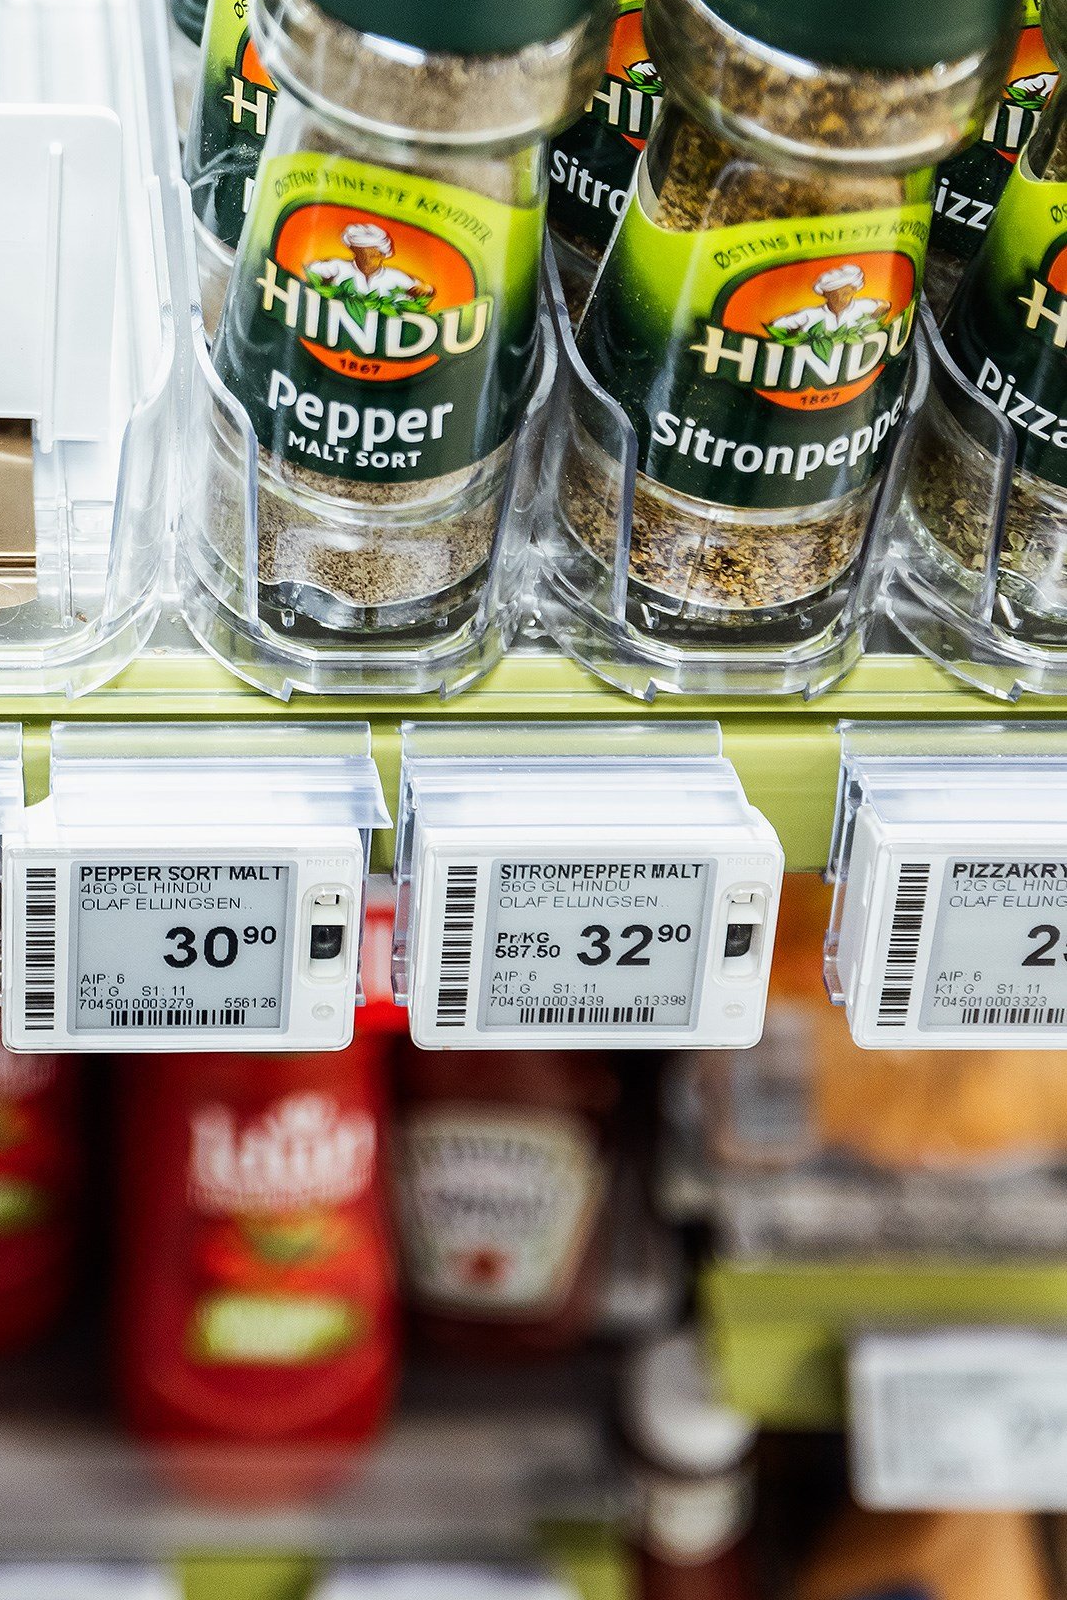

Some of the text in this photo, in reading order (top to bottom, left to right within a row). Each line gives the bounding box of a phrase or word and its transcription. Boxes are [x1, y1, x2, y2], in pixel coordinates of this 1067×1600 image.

[413, 194, 494, 247] KRYDDER
[713, 232, 790, 271] ØSTENS
[256, 258, 493, 359] HINDU
[689, 298, 917, 390] HINDU
[338, 357, 382, 376] 1867
[800, 392, 840, 407] 1867
[266, 368, 454, 452] Pepper
[651, 394, 907, 482] Sitronpeppe
[287, 430, 422, 470] MALT SORT
[81, 866, 283, 882] PEPPER SORT MALT
[500, 864, 704, 880] SITRONPEPPER MALT
[80, 882, 212, 895] 46G GL HINDU
[499, 880, 632, 893] 56G GL HINDU
[953, 879, 987, 892] 12G
[992, 879, 1017, 892] GL
[81, 897, 131, 911] OLAF
[499, 896, 549, 909] OLAF
[949, 895, 999, 908] OLAF
[497, 932, 551, 945] Pr/KG
[576, 924, 692, 967] 32 90
[1021, 924, 1067, 967] 2
[163, 925, 277, 969] 30 90
[494, 945, 561, 959] 587.50
[115, 973, 126, 985] 6
[528, 971, 538, 982] 6
[973, 971, 982, 982] 6
[519, 983, 531, 994] G
[582, 983, 597, 994] 11
[79, 997, 277, 1010] 7045010003279 556126
[490, 995, 687, 1007] 7045010003439 613398
[933, 996, 1048, 1008] 7045010003323
